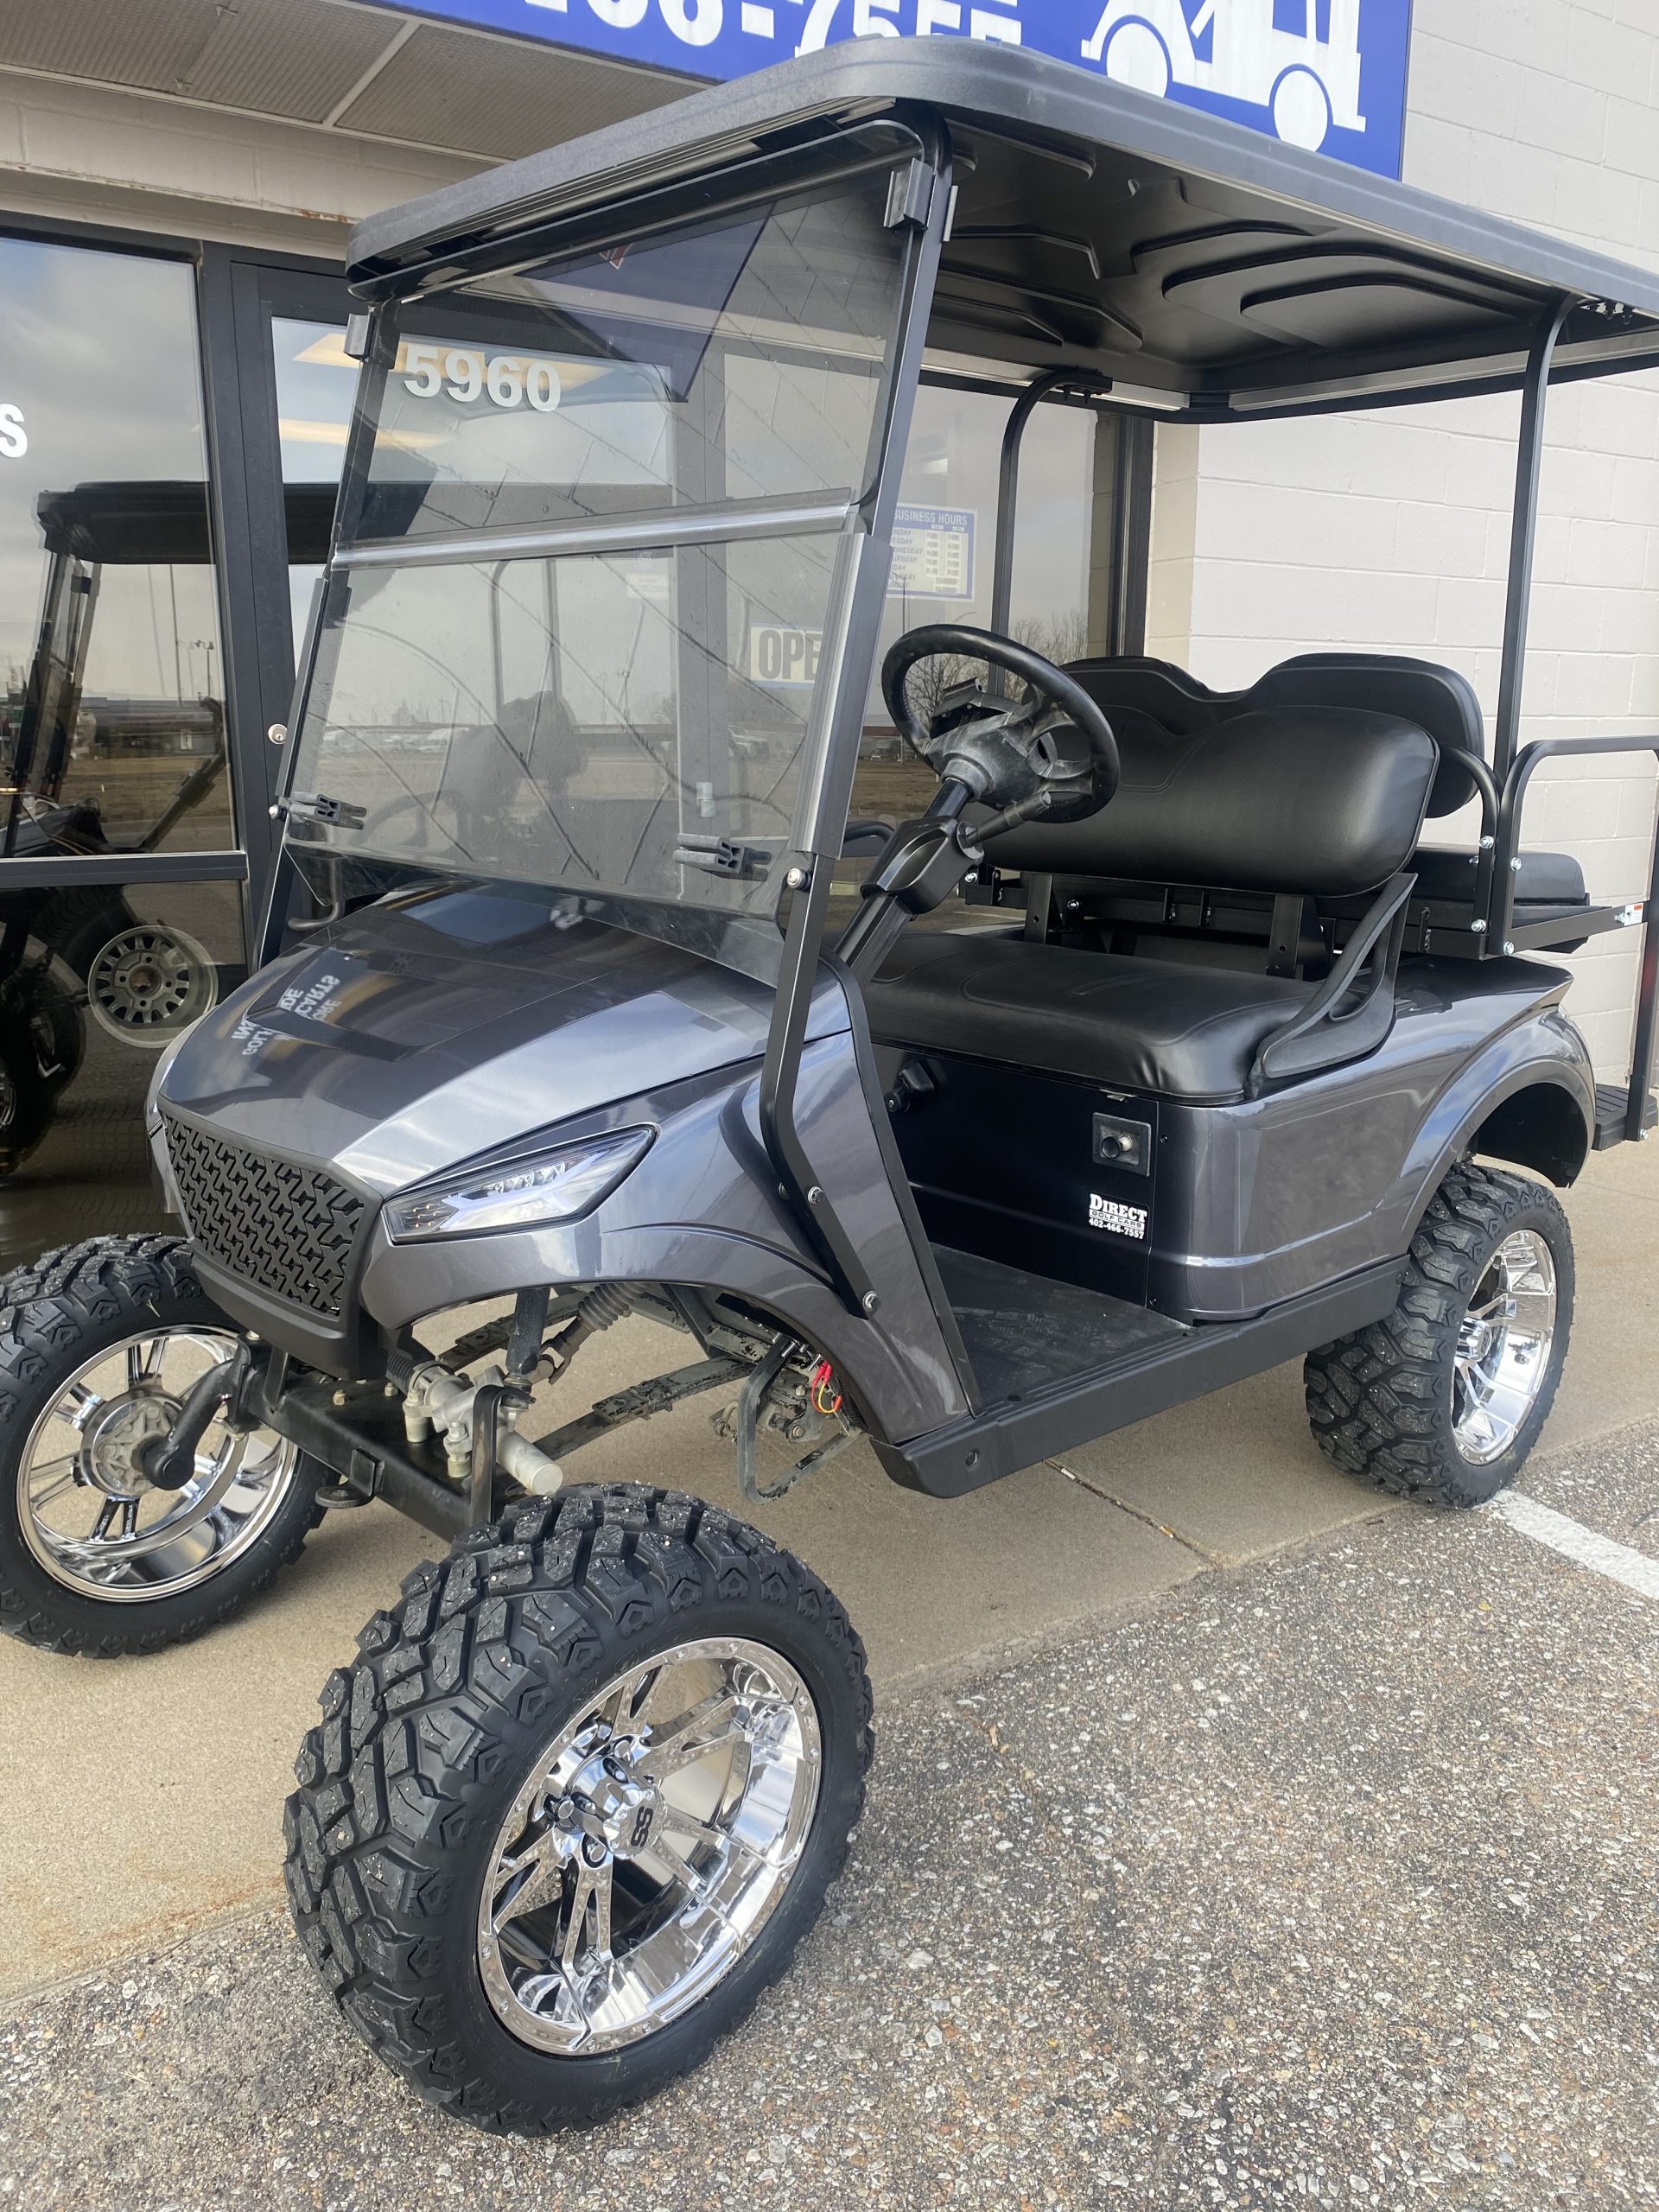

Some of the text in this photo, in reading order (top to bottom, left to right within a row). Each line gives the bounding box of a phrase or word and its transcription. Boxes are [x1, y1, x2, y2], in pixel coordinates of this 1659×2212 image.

[404, 345, 561, 412] 5960
[938, 512, 968, 526] HOURS
[759, 629, 822, 680] OPE
[1090, 1193, 1147, 1223] DIRECT
[1091, 1211, 1115, 1220] GOLF
[1089, 1217, 1145, 1239] 402-466-7557
